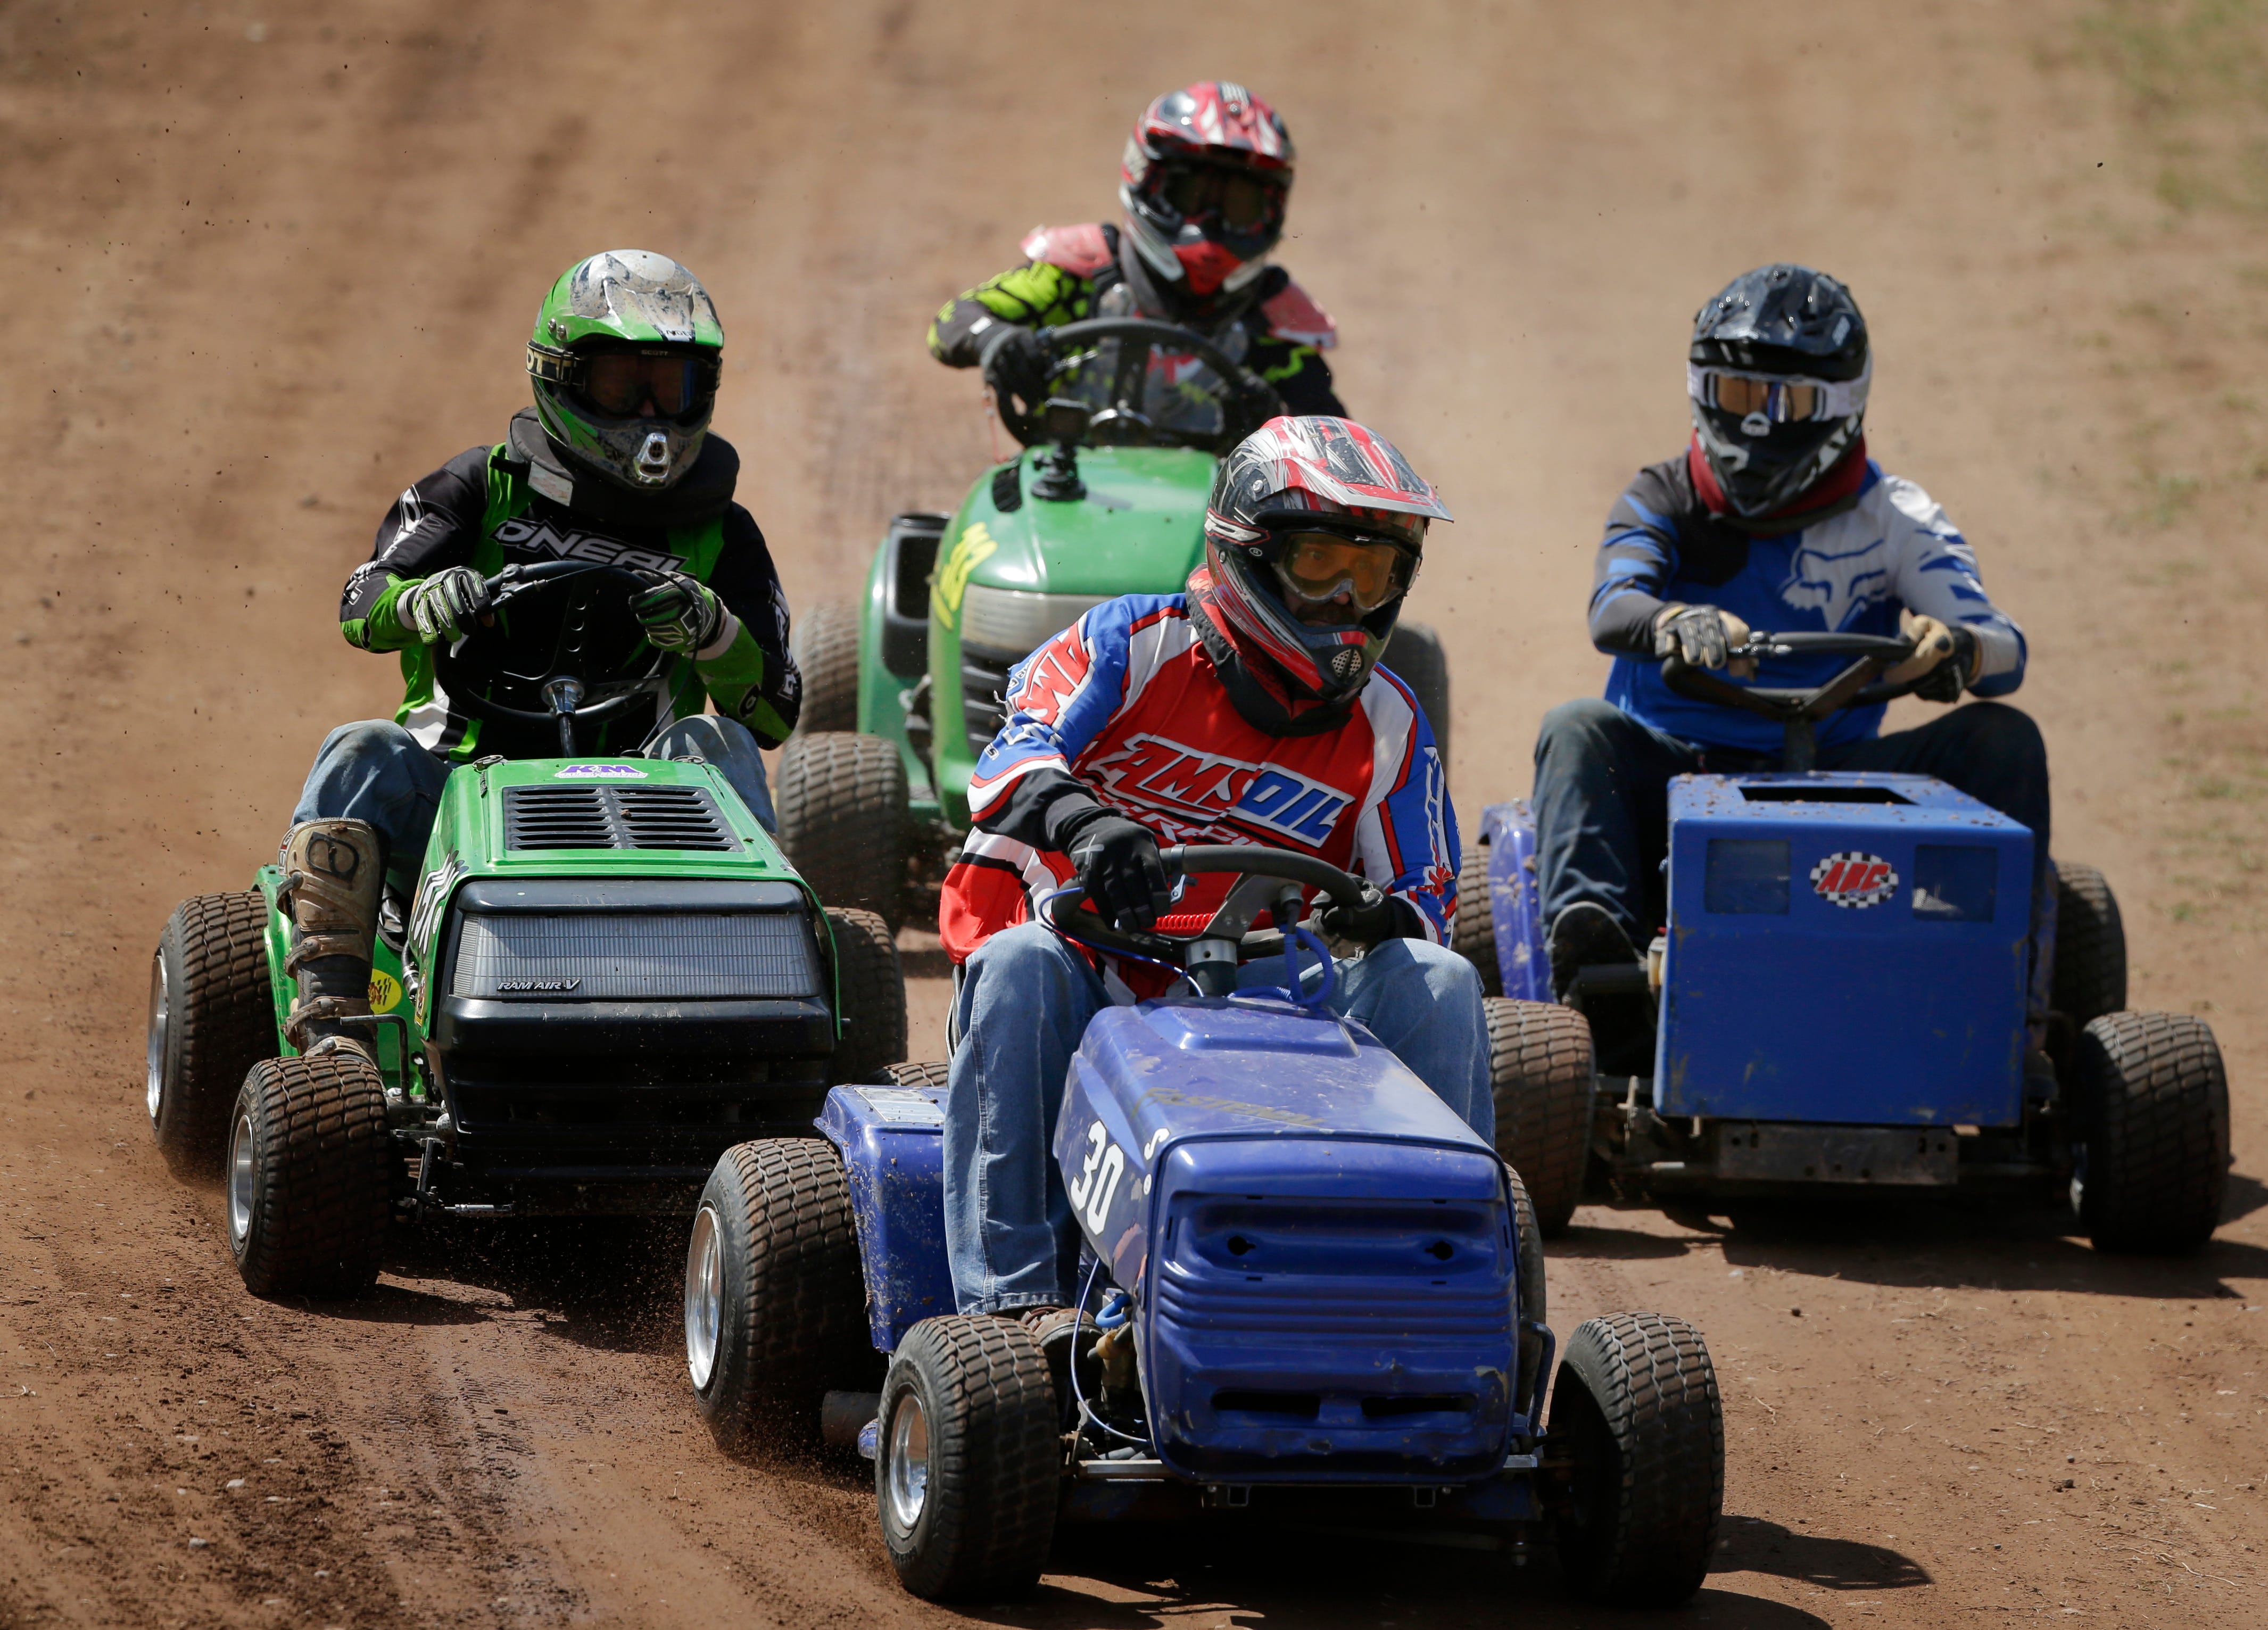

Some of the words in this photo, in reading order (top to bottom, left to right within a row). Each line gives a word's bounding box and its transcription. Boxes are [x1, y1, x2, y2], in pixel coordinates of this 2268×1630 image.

[1086, 735, 1354, 846] AMSOIL
[497, 981, 534, 991] RAM
[534, 981, 563, 991] AIR
[564, 978, 581, 991] V
[1070, 1119, 1124, 1236] 30
